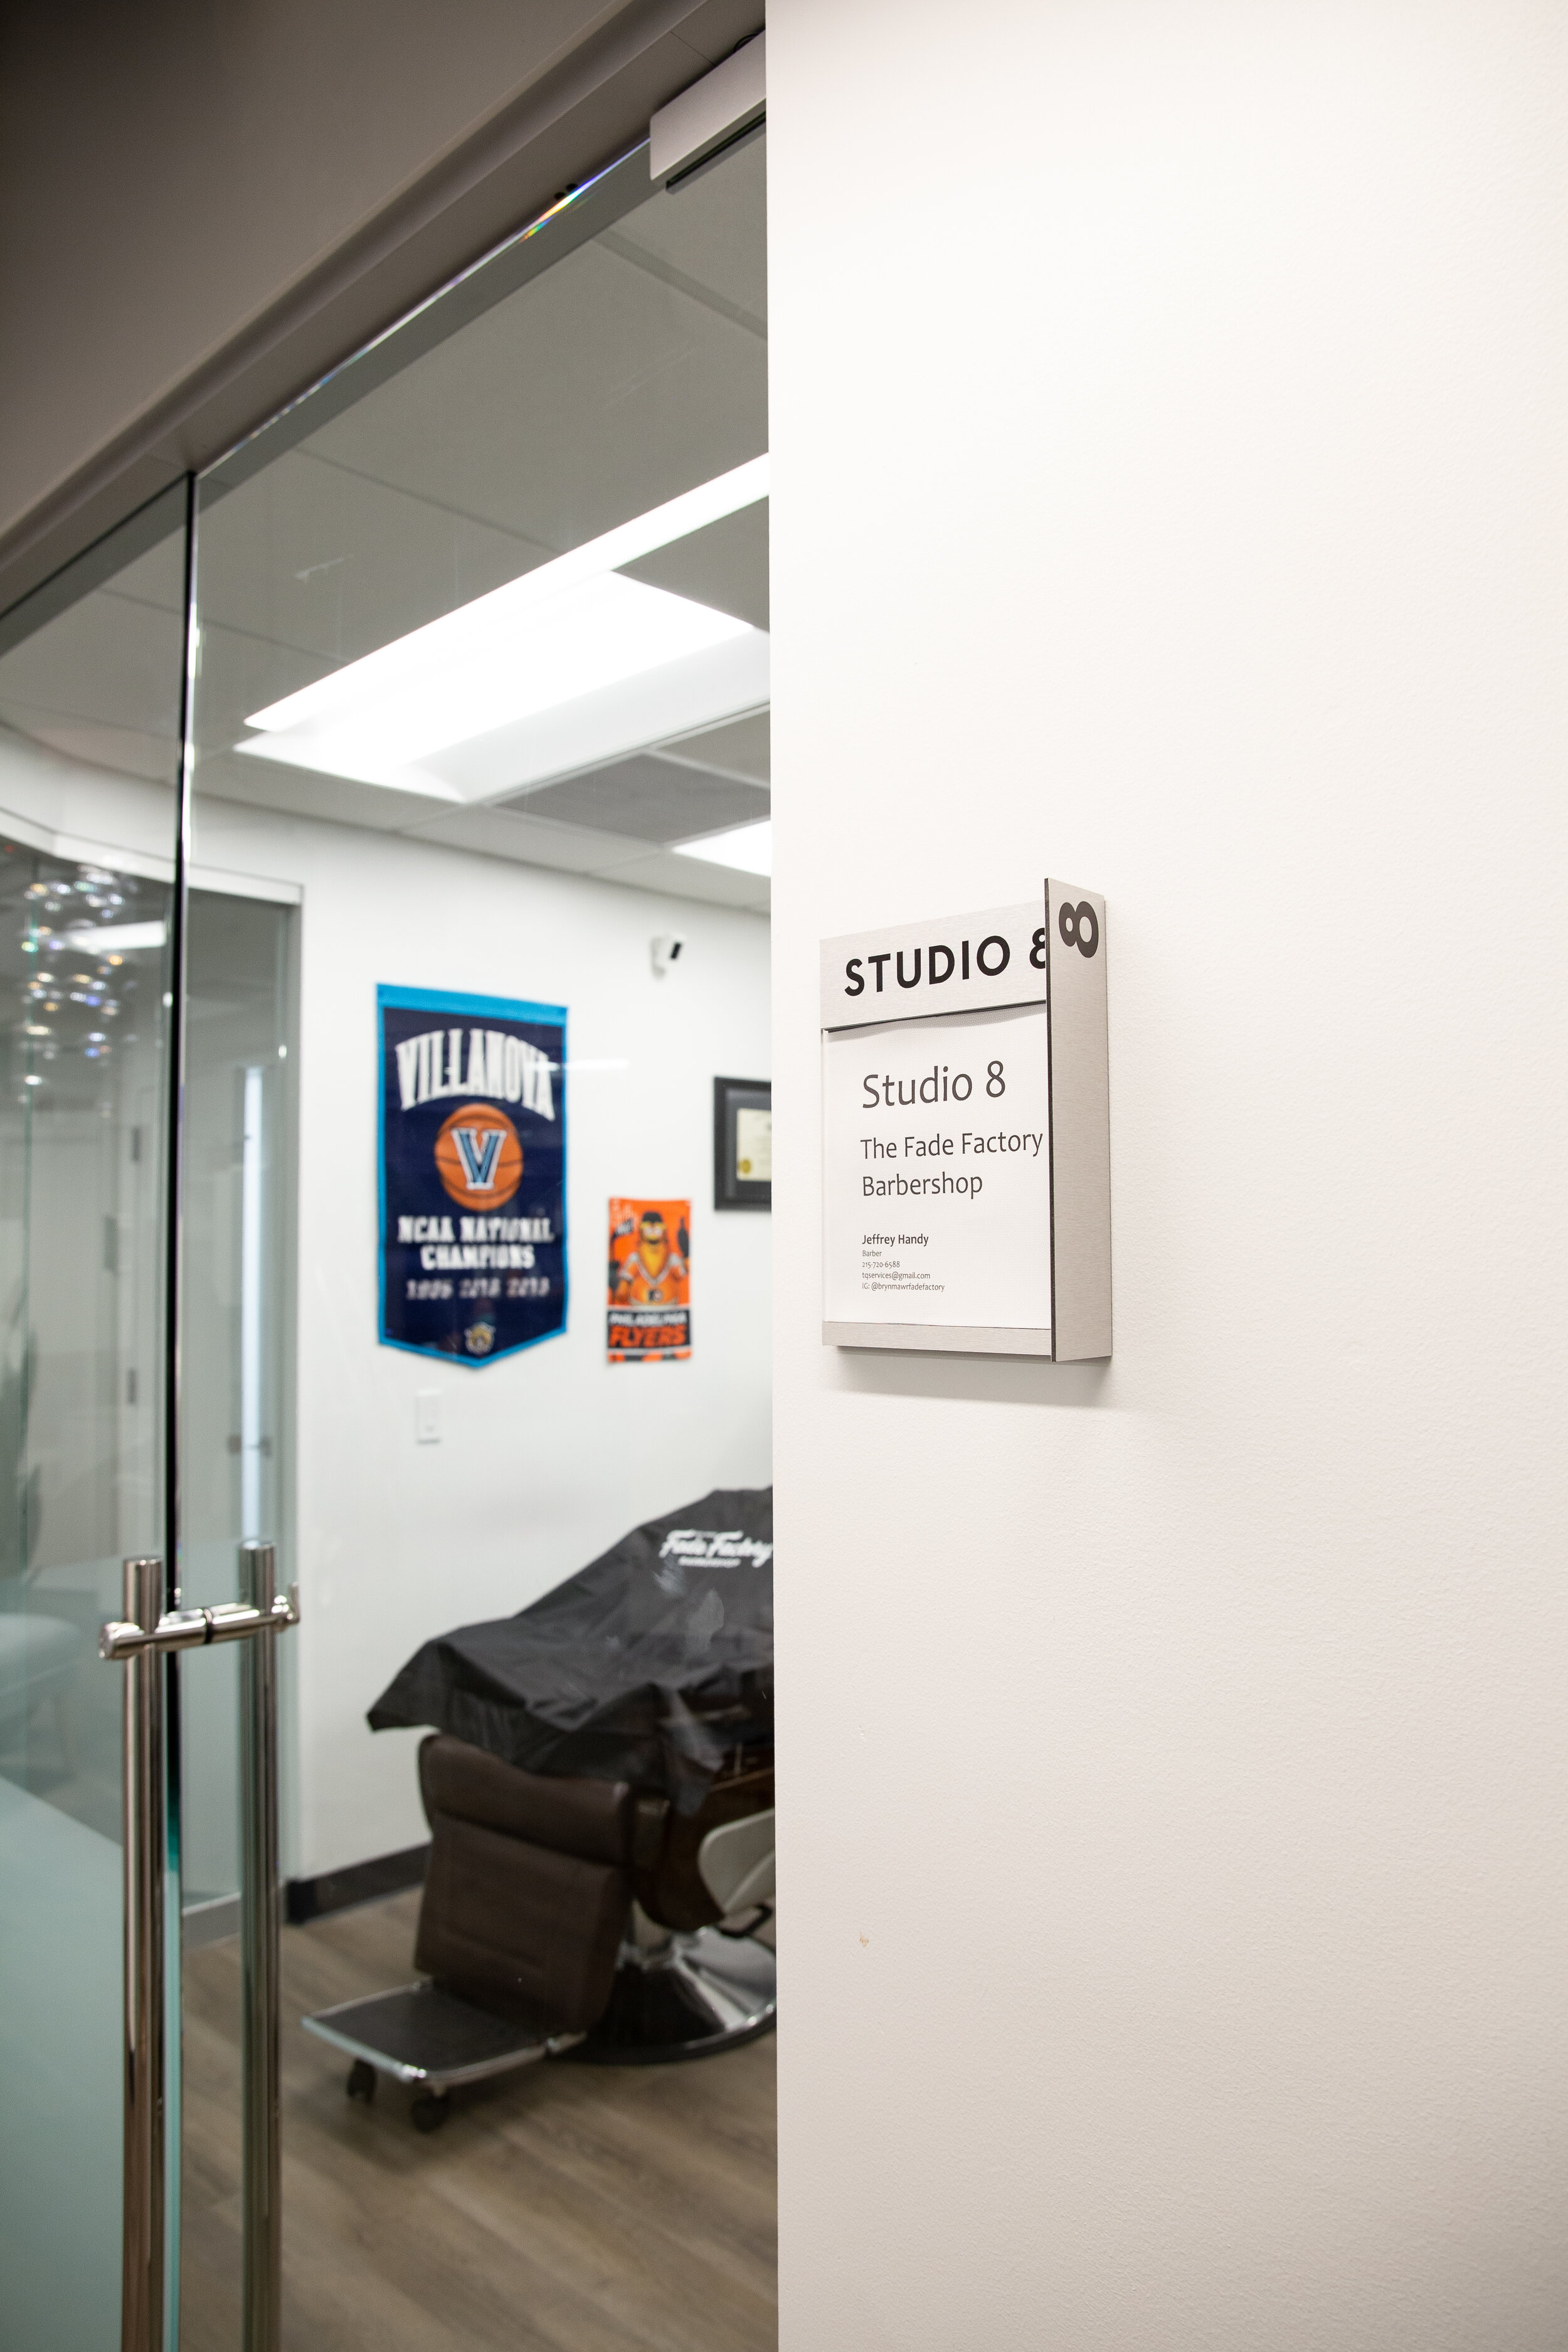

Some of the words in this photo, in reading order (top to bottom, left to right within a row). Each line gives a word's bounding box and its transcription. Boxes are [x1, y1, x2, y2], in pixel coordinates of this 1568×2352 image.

[1058, 901, 1099, 958] 8
[844, 935, 1010, 997] STUDIO
[395, 1027, 556, 1122] VILLANOVA
[862, 1066, 973, 1109] Studio
[986, 1060, 1006, 1098] 8
[860, 1137, 898, 1160] The
[904, 1133, 954, 1157] Fade
[961, 1131, 1044, 1157] Factory
[862, 1171, 983, 1200] Barbershop
[398, 1216, 456, 1244] NCAA
[862, 1234, 896, 1248] Jeffrey
[898, 1233, 929, 1247] Handy
[862, 1261, 901, 1269] 215-720-6588
[862, 1271, 931, 1281] tqservices@gmail.com
[871, 1281, 945, 1293] @brynmawrfadefactory
